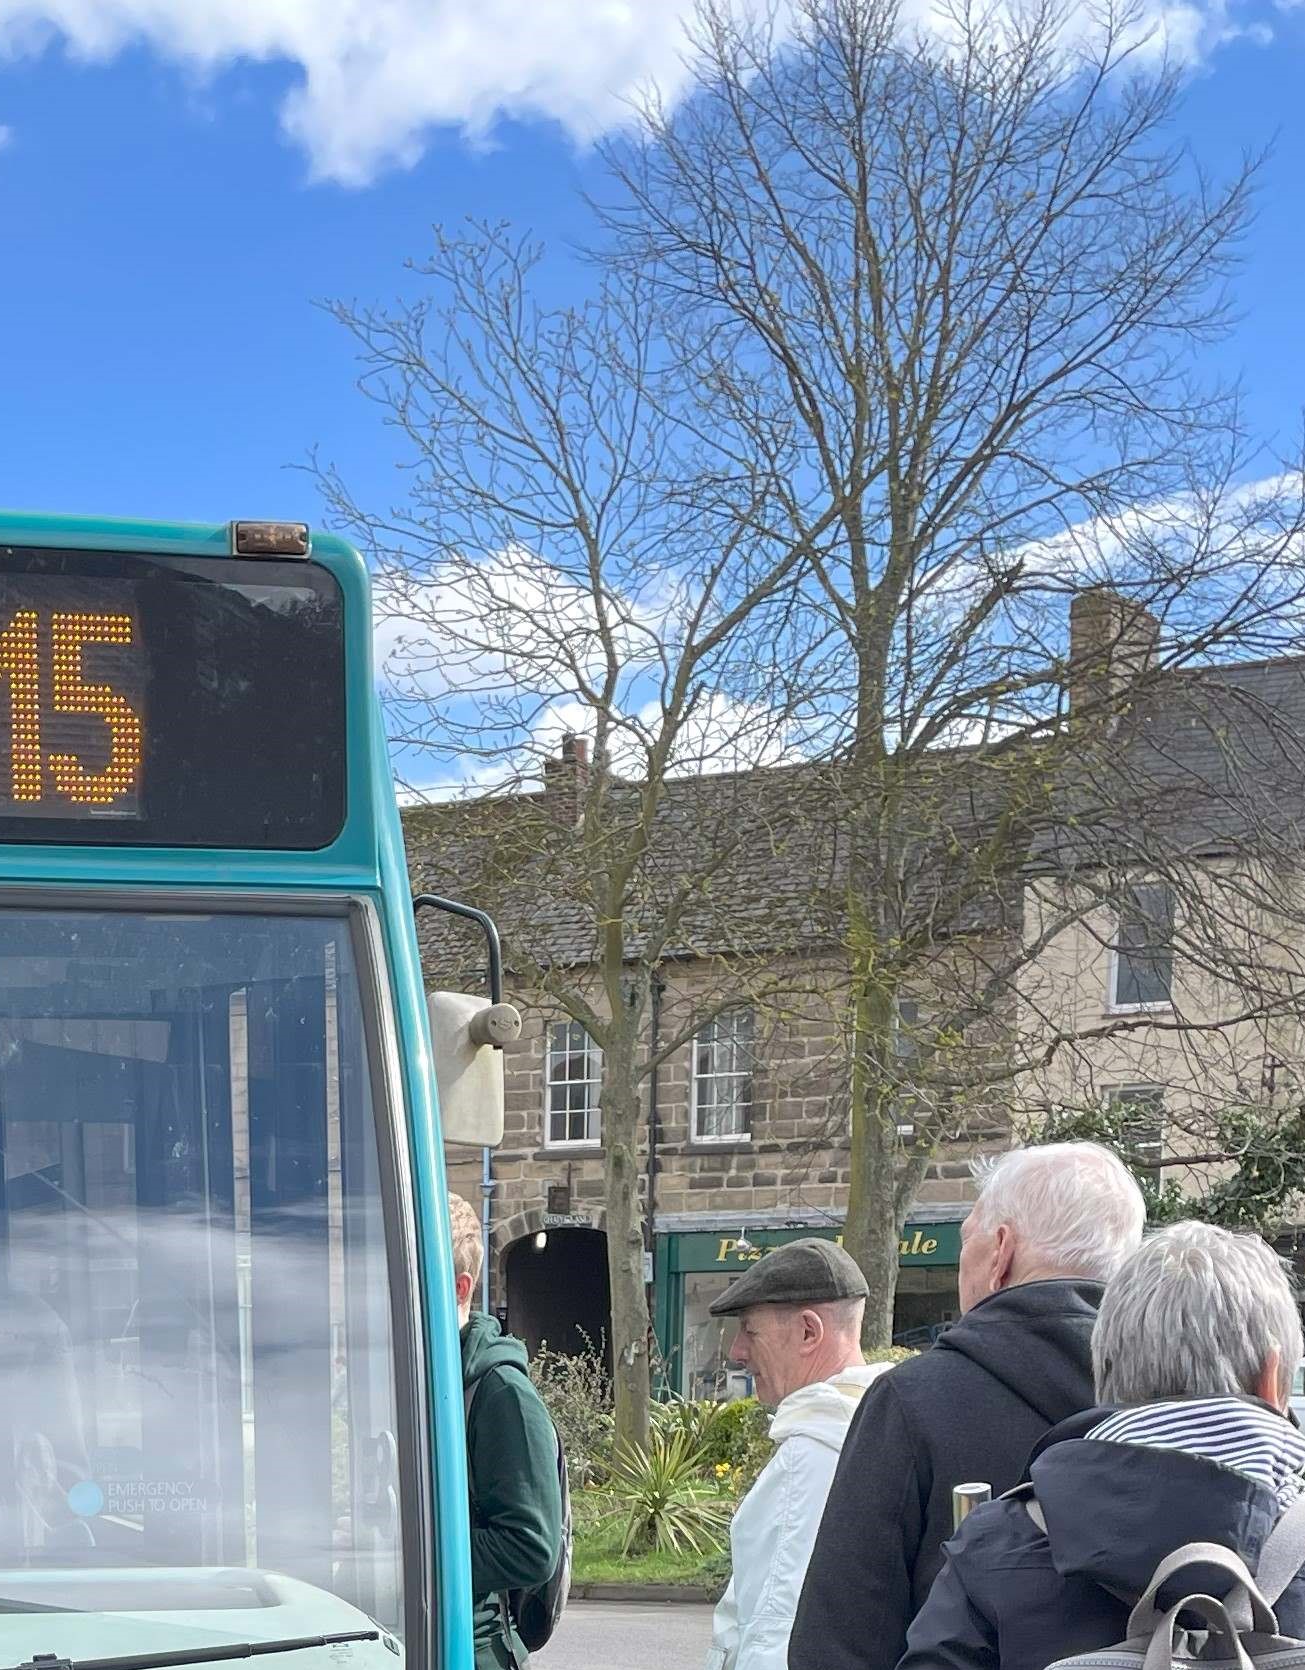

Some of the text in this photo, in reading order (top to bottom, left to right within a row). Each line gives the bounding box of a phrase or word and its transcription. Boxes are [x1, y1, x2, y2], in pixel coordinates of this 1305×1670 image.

[108, 1481, 194, 1497] EMERGENCY
[108, 1498, 208, 1513] PUSH TO OPEN
